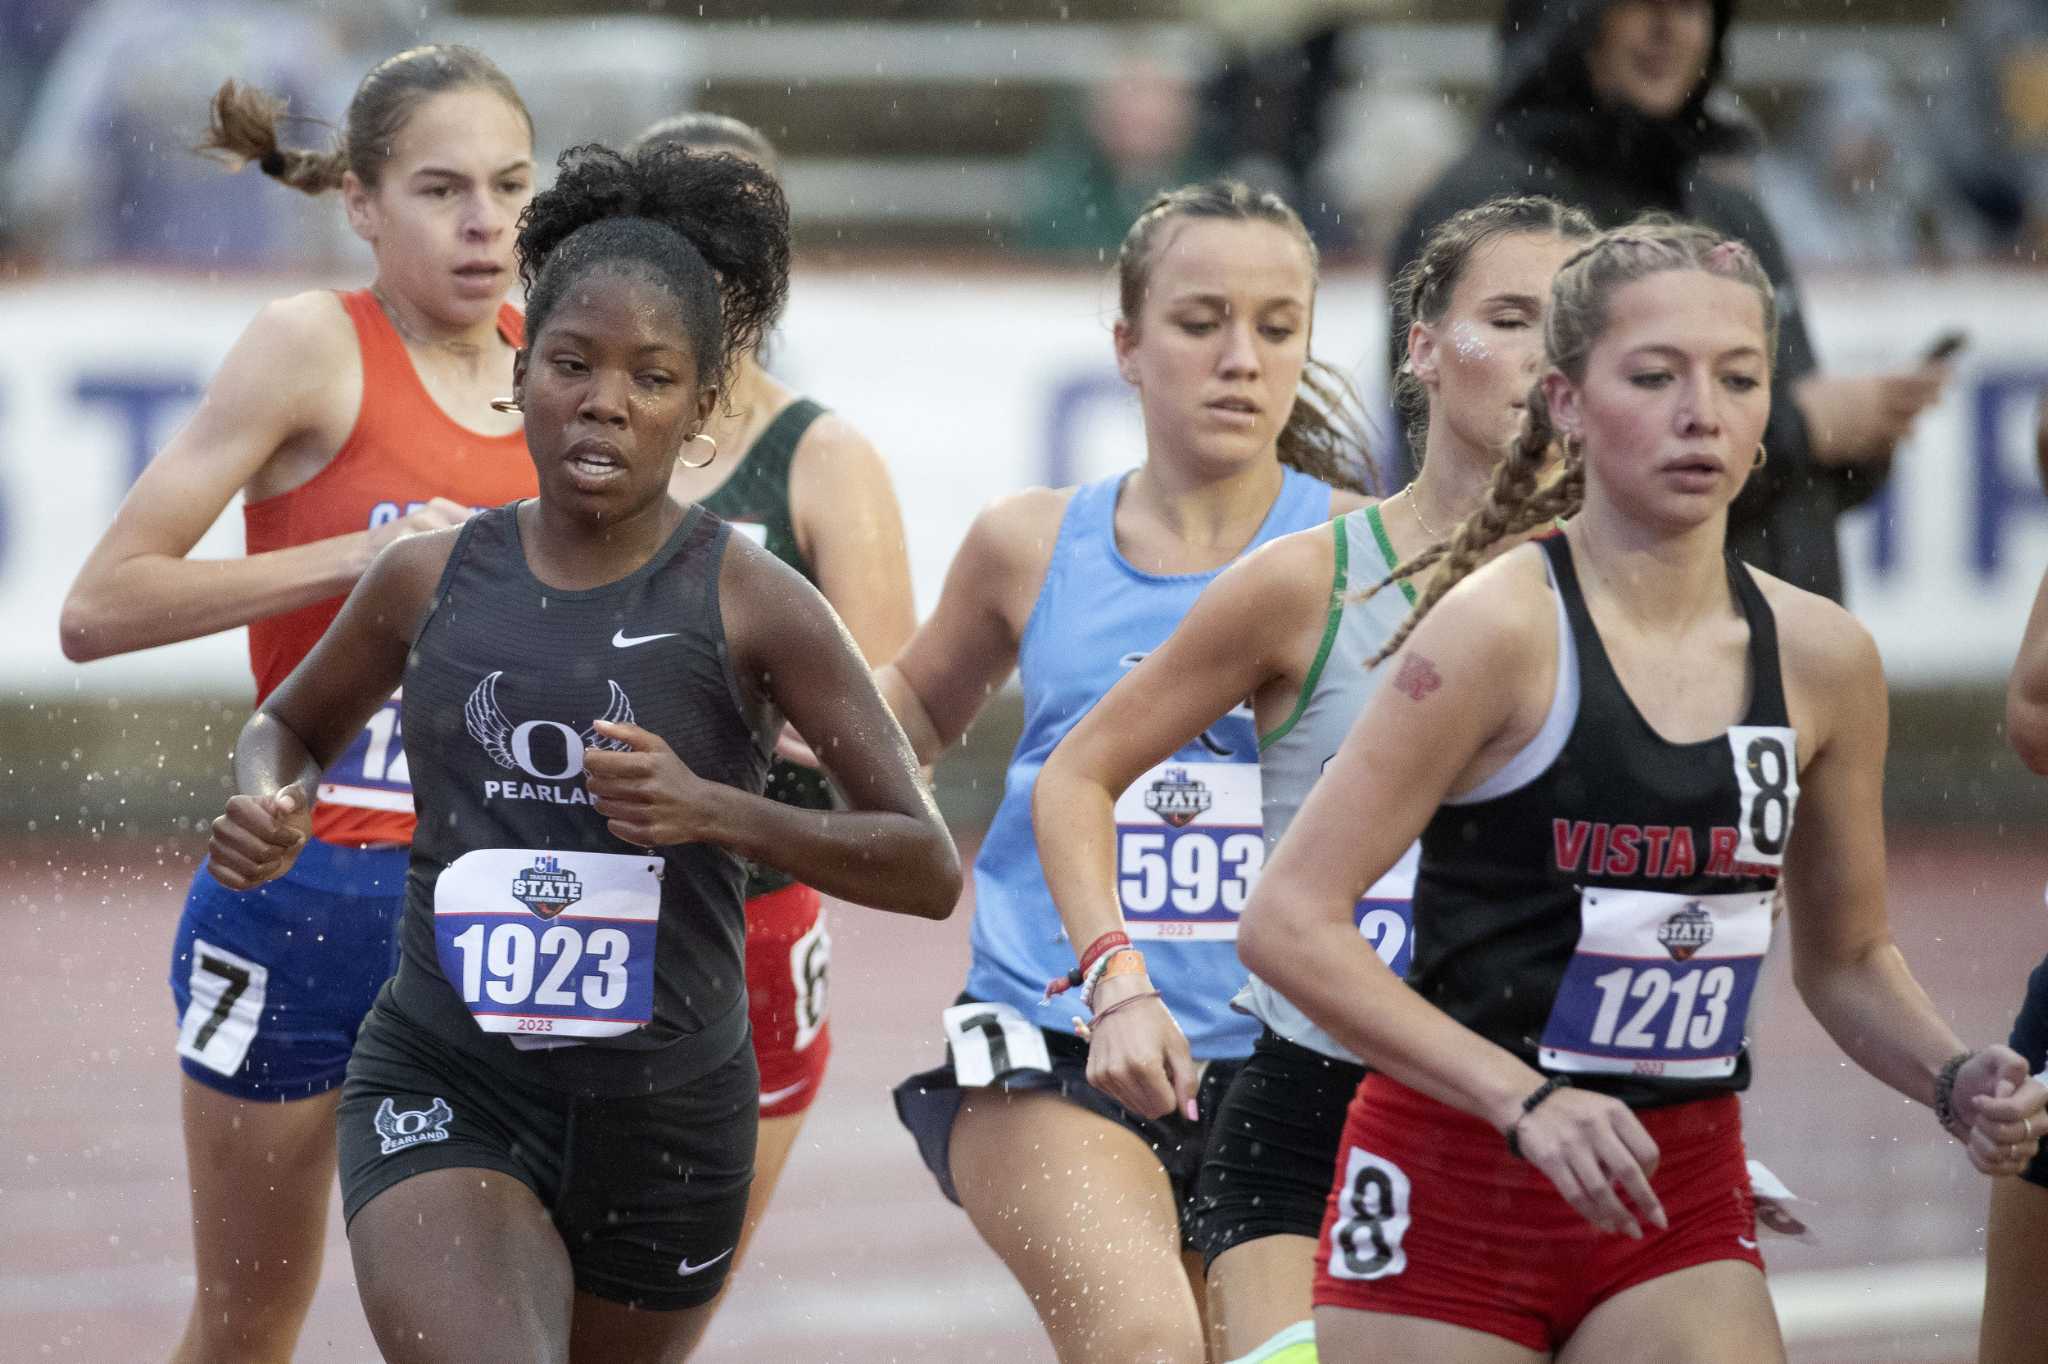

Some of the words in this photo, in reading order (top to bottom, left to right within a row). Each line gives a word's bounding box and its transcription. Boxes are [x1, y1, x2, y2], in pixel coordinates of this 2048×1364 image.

[511, 720, 585, 779] O
[484, 780, 599, 806] PEARLA
[1146, 791, 1211, 808] STATE
[1746, 736, 1789, 856] 8
[1121, 833, 1264, 913] 593
[1553, 818, 1696, 878] VISTA
[513, 879, 581, 899] STATE
[1659, 923, 1712, 941] STATE
[453, 923, 630, 1010] 1923
[192, 954, 250, 1052] 7
[517, 1019, 554, 1032] 2023
[1590, 966, 1735, 1049] 1213
[1339, 1166, 1394, 1274] 8
